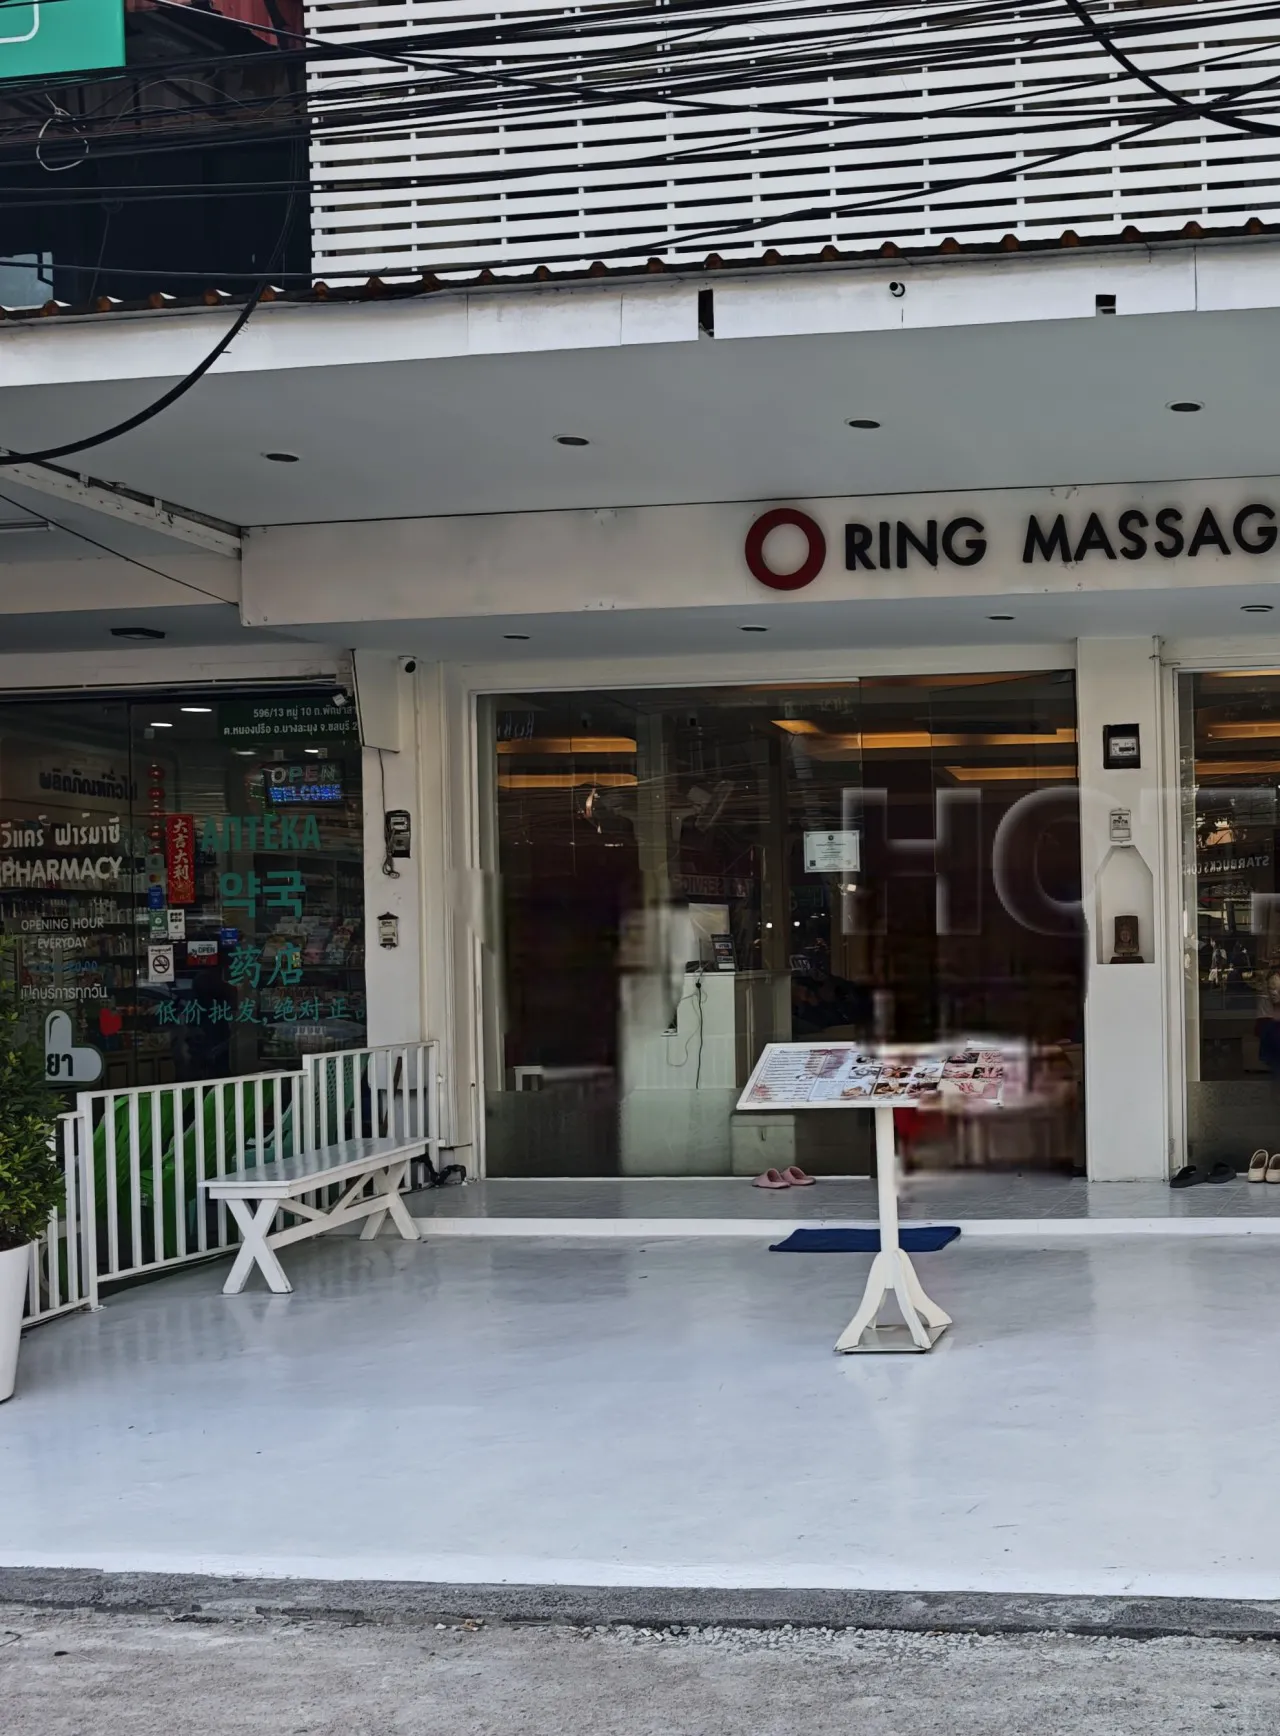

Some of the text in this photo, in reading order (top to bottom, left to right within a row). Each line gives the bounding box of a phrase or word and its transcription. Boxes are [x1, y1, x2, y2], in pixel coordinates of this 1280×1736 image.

[301, 706, 312, 717] 10
[271, 765, 337, 783] OPEN
[172, 818, 190, 881] 大吉大利
[1, 855, 124, 884] PHARMACY
[219, 869, 307, 919] 약국
[21, 916, 105, 931] OPENING HOUR
[38, 935, 88, 949] EVERYDAY
[226, 942, 305, 989] 药店
[47, 1053, 74, 1077] ยา
